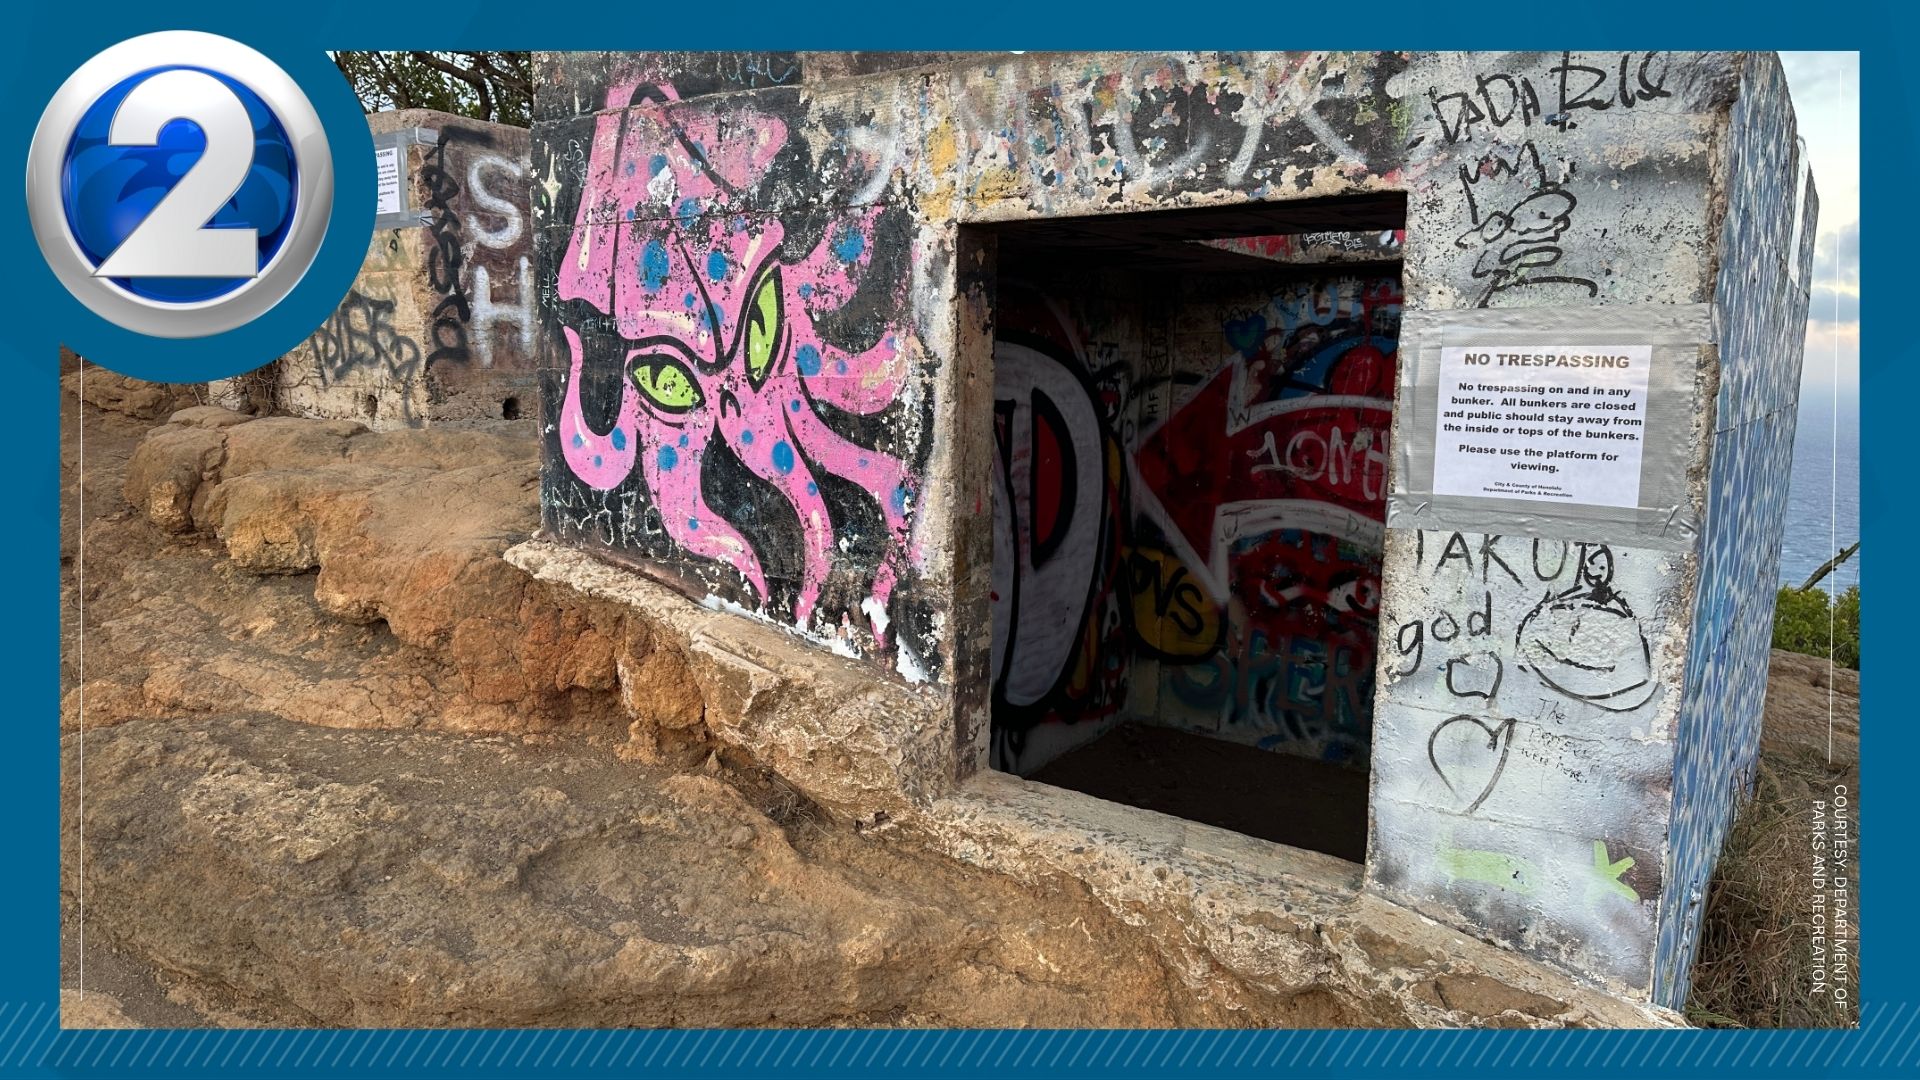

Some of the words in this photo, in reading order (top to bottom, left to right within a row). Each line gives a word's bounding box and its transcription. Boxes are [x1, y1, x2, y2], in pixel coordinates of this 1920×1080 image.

[1464, 353, 1491, 366] NO
[1496, 354, 1630, 369] TRESPASSING
[1458, 382, 1474, 391] No
[1477, 383, 1545, 396] trespassing
[1548, 386, 1564, 394] on
[1567, 386, 1590, 395] and
[1593, 386, 1605, 396] in
[1607, 388, 1631, 398] any
[1451, 396, 1494, 406] bunker.
[1500, 397, 1516, 407] All
[1519, 399, 1567, 409] bunkers
[1570, 401, 1591, 409] are
[1594, 401, 1636, 411] closed
[1443, 410, 1464, 418] and
[1467, 411, 1502, 421] public
[1505, 412, 1545, 422] should
[1547, 414, 1574, 425] stay
[1576, 417, 1610, 427] away
[1613, 416, 1642, 426] from
[1443, 423, 1462, 432] the
[1465, 424, 1499, 434] inside
[1518, 427, 1544, 438] tops
[1546, 428, 1559, 437] of
[1562, 429, 1582, 438] the
[1585, 429, 1639, 441] bunkers.
[1458, 444, 1497, 455] Please
[1500, 448, 1521, 456] use
[1524, 448, 1544, 457] the
[1546, 449, 1598, 461] platform
[1601, 452, 1619, 461] for
[1510, 461, 1560, 474] viewing.
